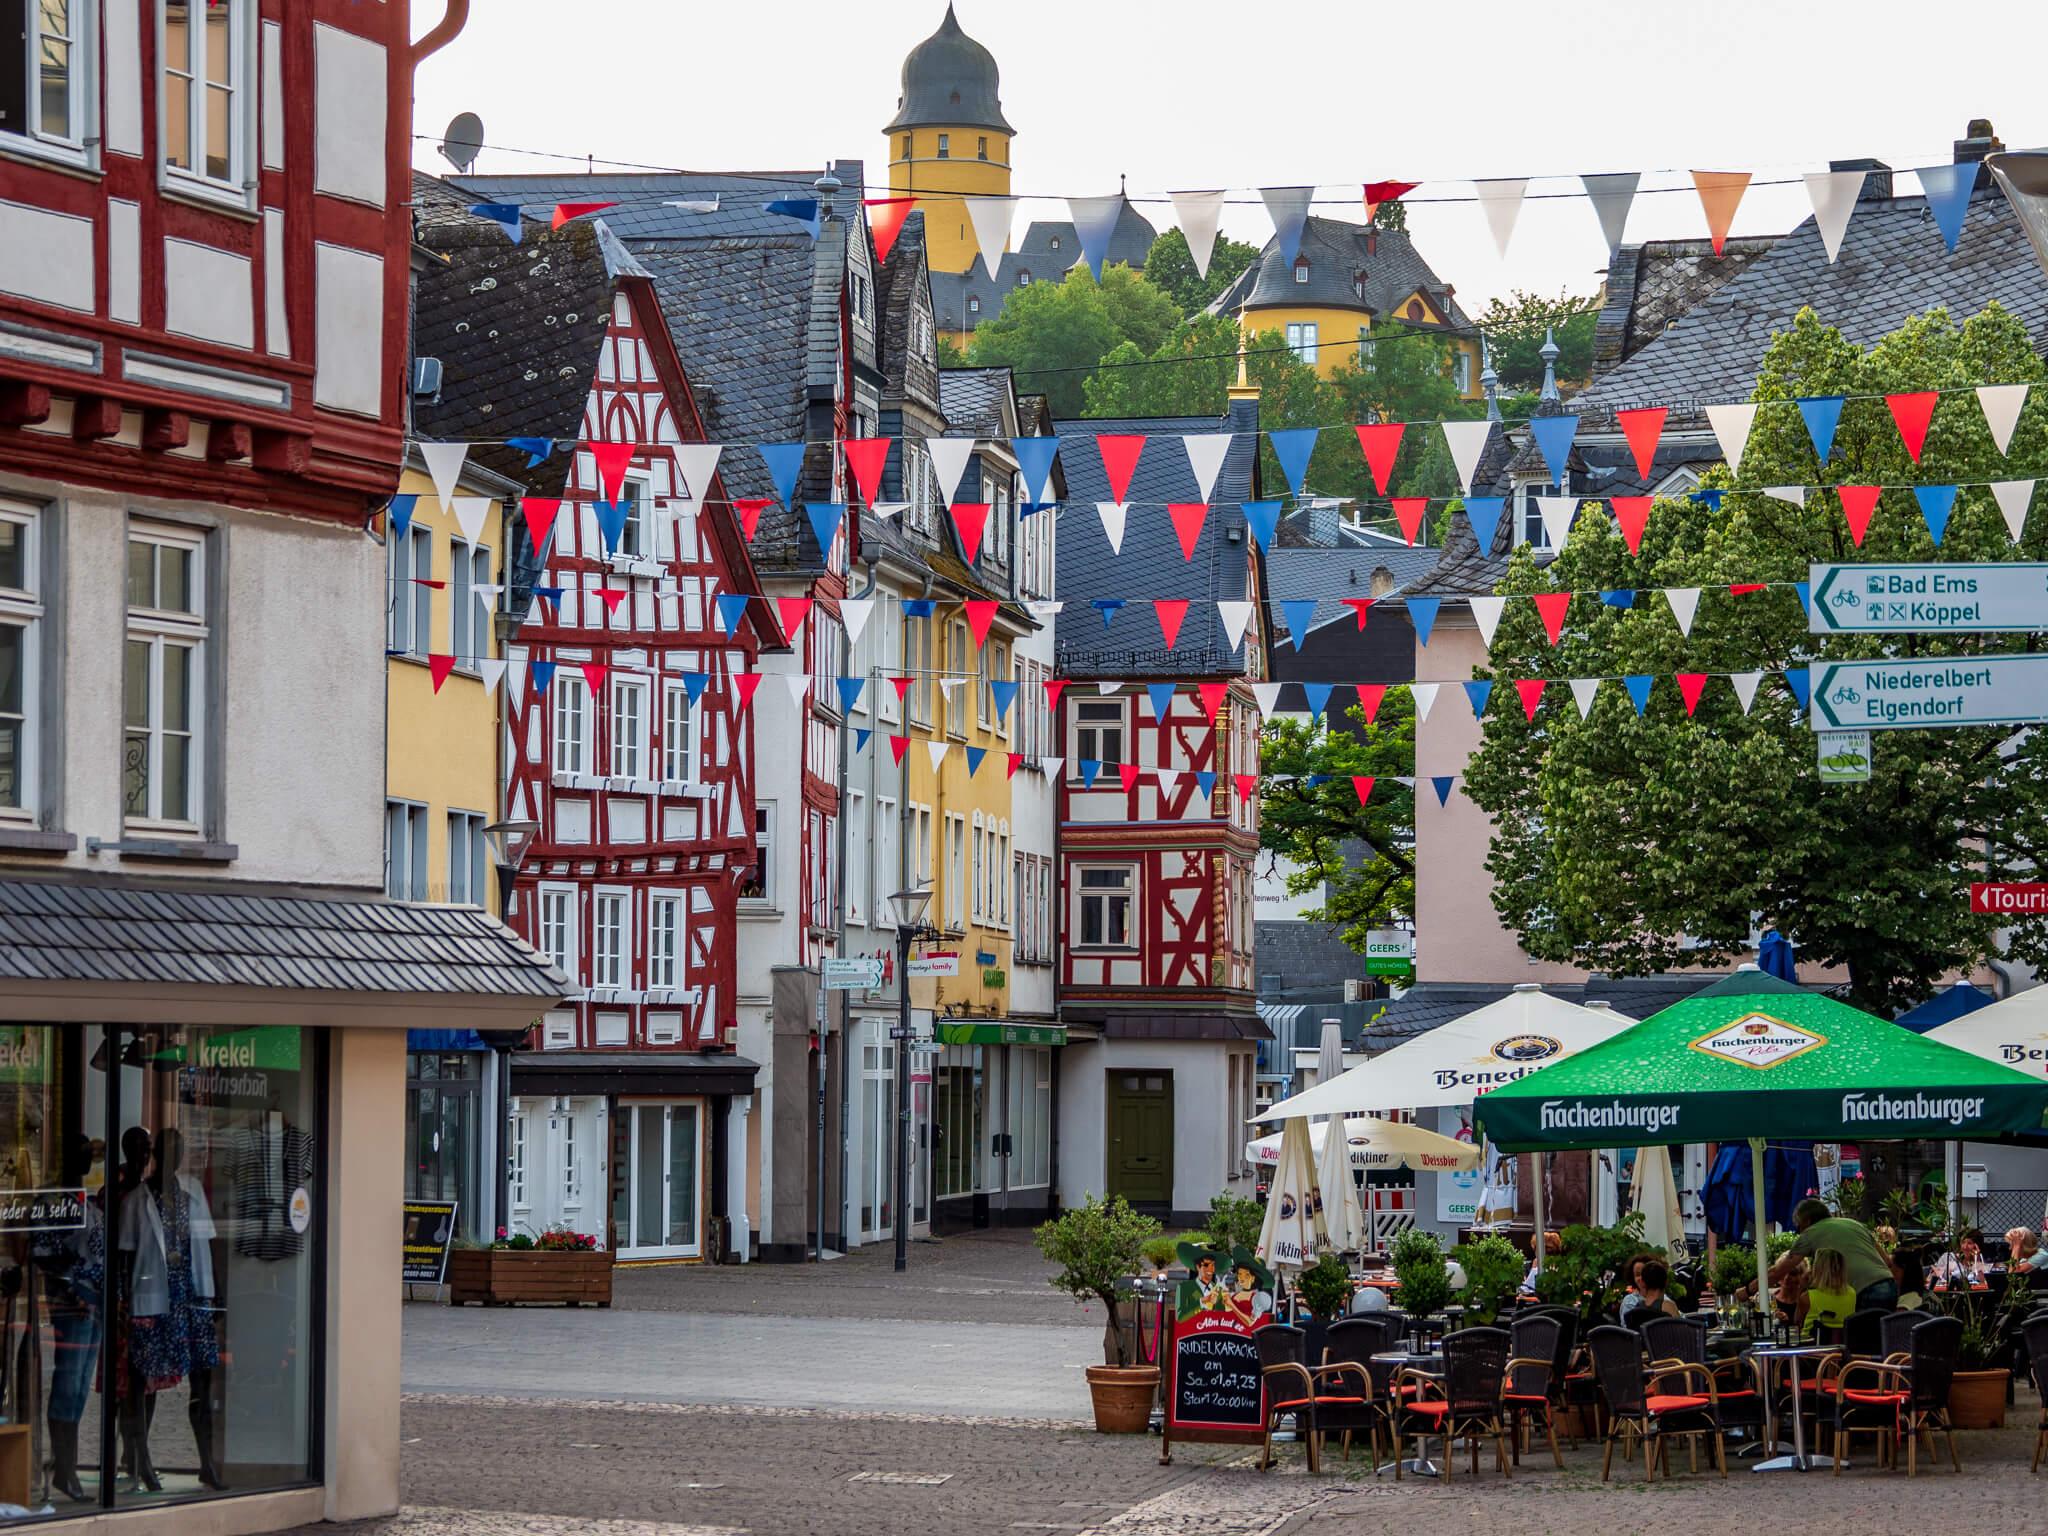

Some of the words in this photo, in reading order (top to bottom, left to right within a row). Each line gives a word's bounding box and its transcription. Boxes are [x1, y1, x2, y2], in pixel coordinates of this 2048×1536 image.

[1889, 575, 1926, 593] Bad
[1934, 575, 1978, 593] Ems
[1911, 602, 1981, 624] Köppel
[1866, 669, 1991, 690] Niederelbert
[1867, 696, 1963, 720] Elgendorf
[1254, 894, 1279, 903] teinweg
[1990, 887, 2048, 909] Touri
[1370, 944, 1400, 952] GEERS
[200, 1037, 256, 1068] krekel
[1998, 1044, 2048, 1064] Be
[1432, 1067, 1543, 1089] Benedi
[1420, 1153, 1458, 1167] Weissbier
[30, 1204, 45, 1218] zu
[1448, 1204, 1476, 1213] GEERS
[1204, 1360, 1222, 1371] am
[1185, 1371, 1208, 1387] Sa.
[1210, 1372, 1256, 1390] 01.07.23
[1183, 1391, 1210, 1406] Start
[1211, 1392, 1241, 1408] 20:00
